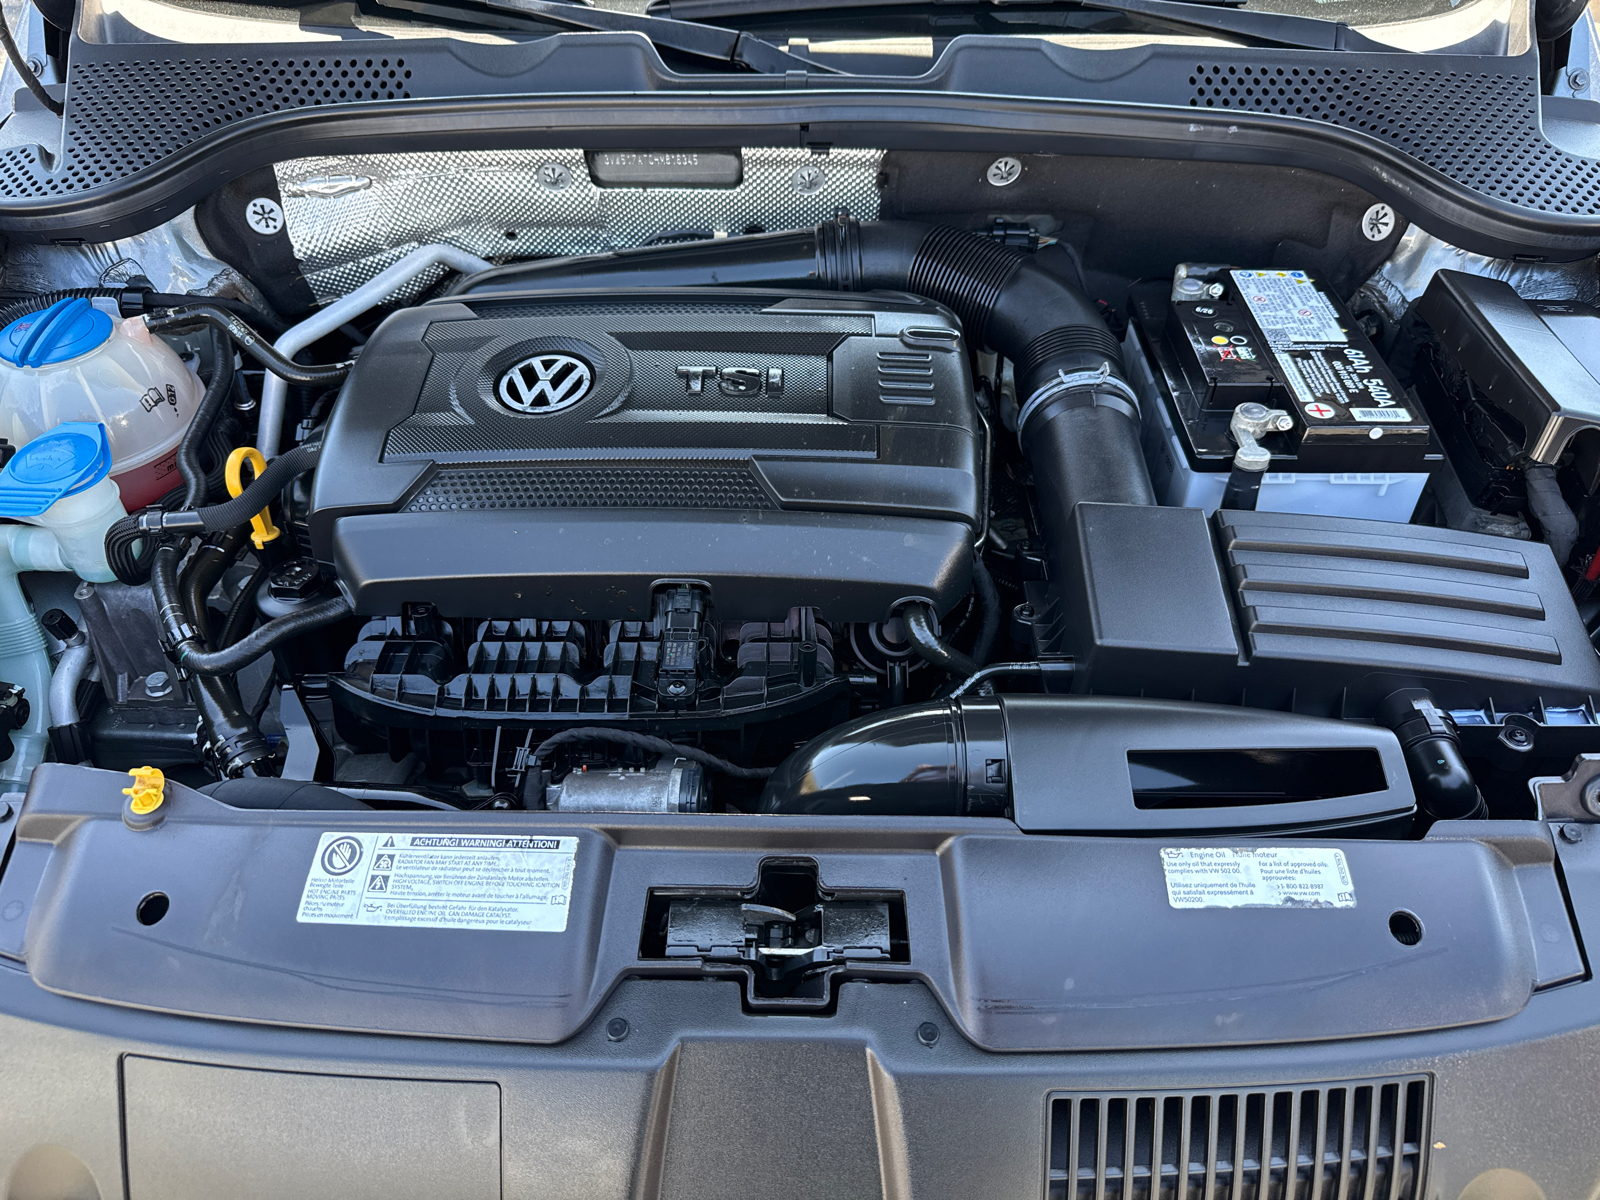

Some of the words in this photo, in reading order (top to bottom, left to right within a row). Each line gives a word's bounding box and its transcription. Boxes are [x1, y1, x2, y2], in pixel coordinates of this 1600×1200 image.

[675, 366, 783, 396] TSI
[1343, 349, 1373, 373] 61Ah
[1362, 379, 1396, 407] 540A
[166, 384, 176, 405] G12
[413, 838, 459, 847] ACHTUNG!
[460, 838, 506, 848] WARNING!
[506, 840, 558, 848] ATTENTION!
[1190, 852, 1214, 860] Engine
